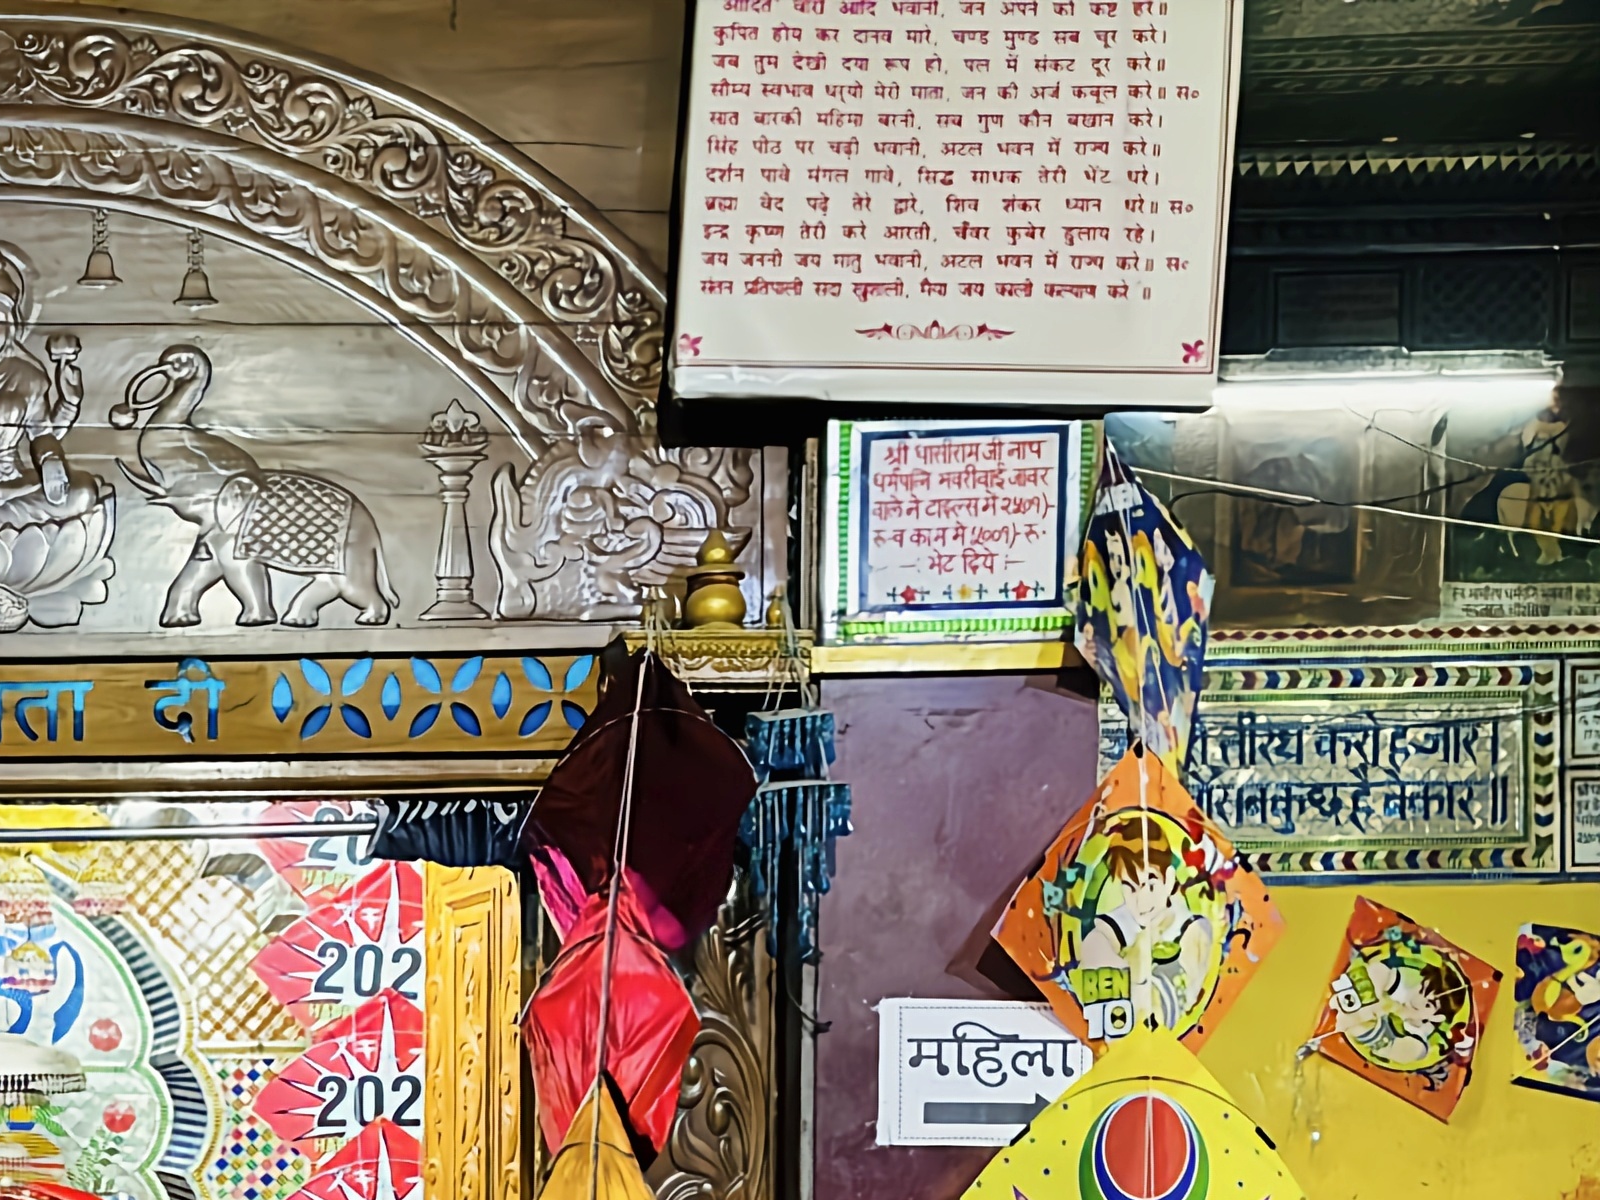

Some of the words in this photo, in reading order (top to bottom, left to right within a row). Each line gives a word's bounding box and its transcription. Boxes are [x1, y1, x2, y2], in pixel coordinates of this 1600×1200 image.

[884, 439, 908, 465] श्री
[982, 436, 1004, 460] जी
[144, 657, 226, 744] दी
[1071, 967, 1131, 1005] BEN
[907, 1021, 1078, 1087] महिला
